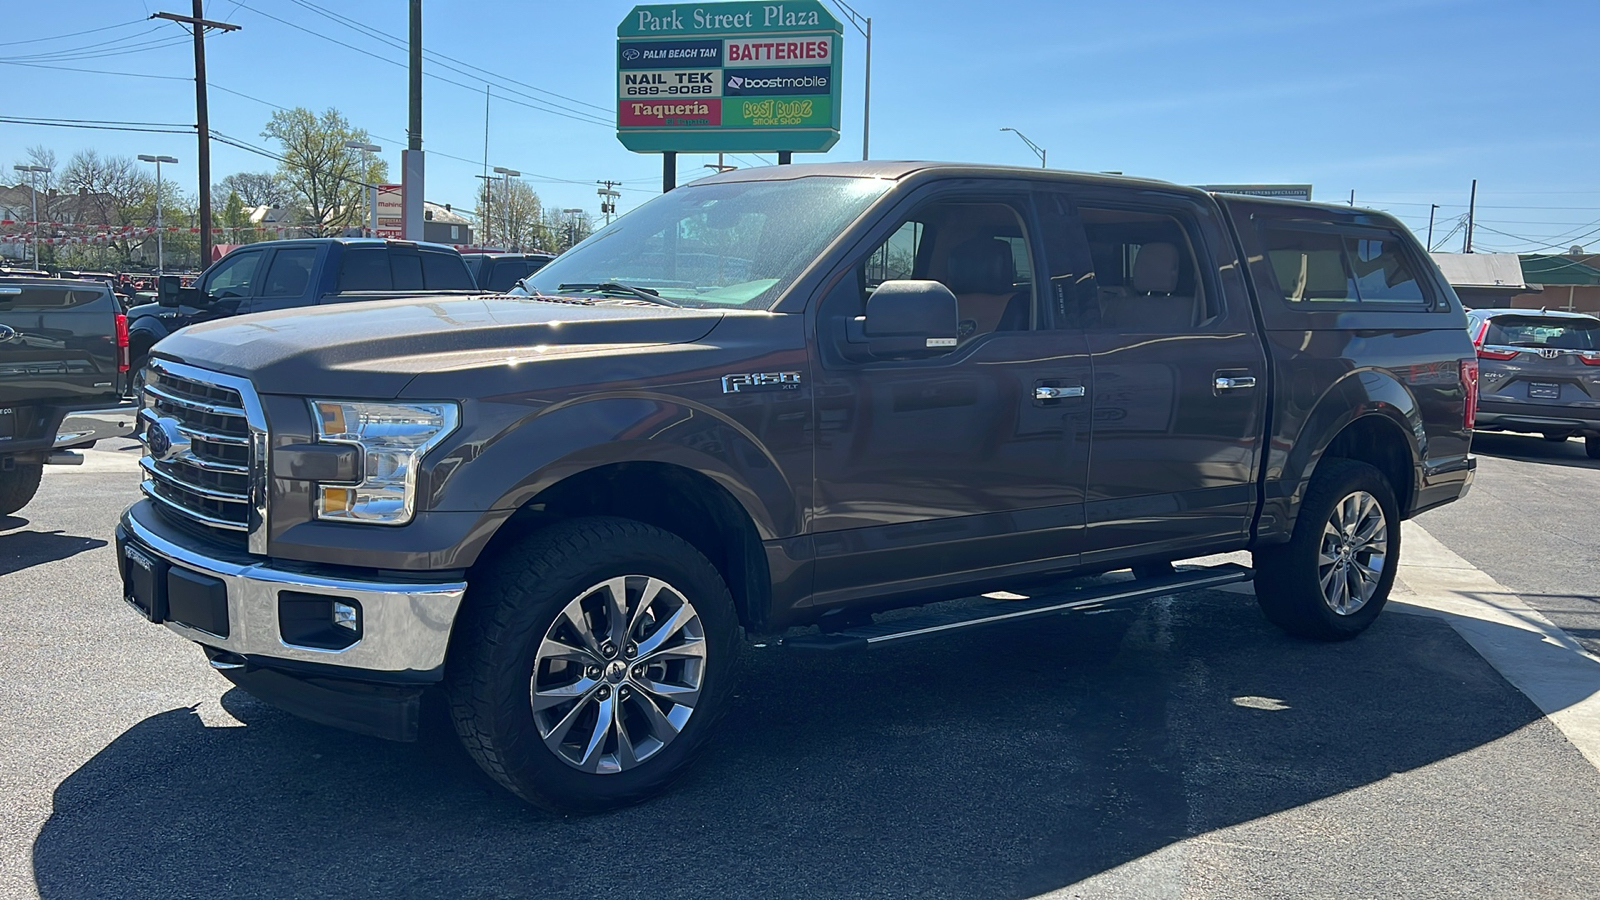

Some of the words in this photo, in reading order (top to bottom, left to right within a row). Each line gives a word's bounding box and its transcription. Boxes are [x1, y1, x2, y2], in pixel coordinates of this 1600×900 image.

[638, 10, 684, 31] Park
[693, 8, 753, 29] Street
[763, 5, 819, 27] Plaza
[643, 50, 667, 59] PALM
[668, 49, 698, 58] BEACH
[700, 48, 717, 58] TAN
[729, 41, 828, 61] BATTERIES
[625, 73, 667, 85] NAIL
[675, 72, 713, 84] TEK
[744, 76, 827, 88] boostmobile
[627, 85, 712, 95] 689-9088
[632, 101, 709, 118] Taquería
[780, 117, 802, 125] SHOP
